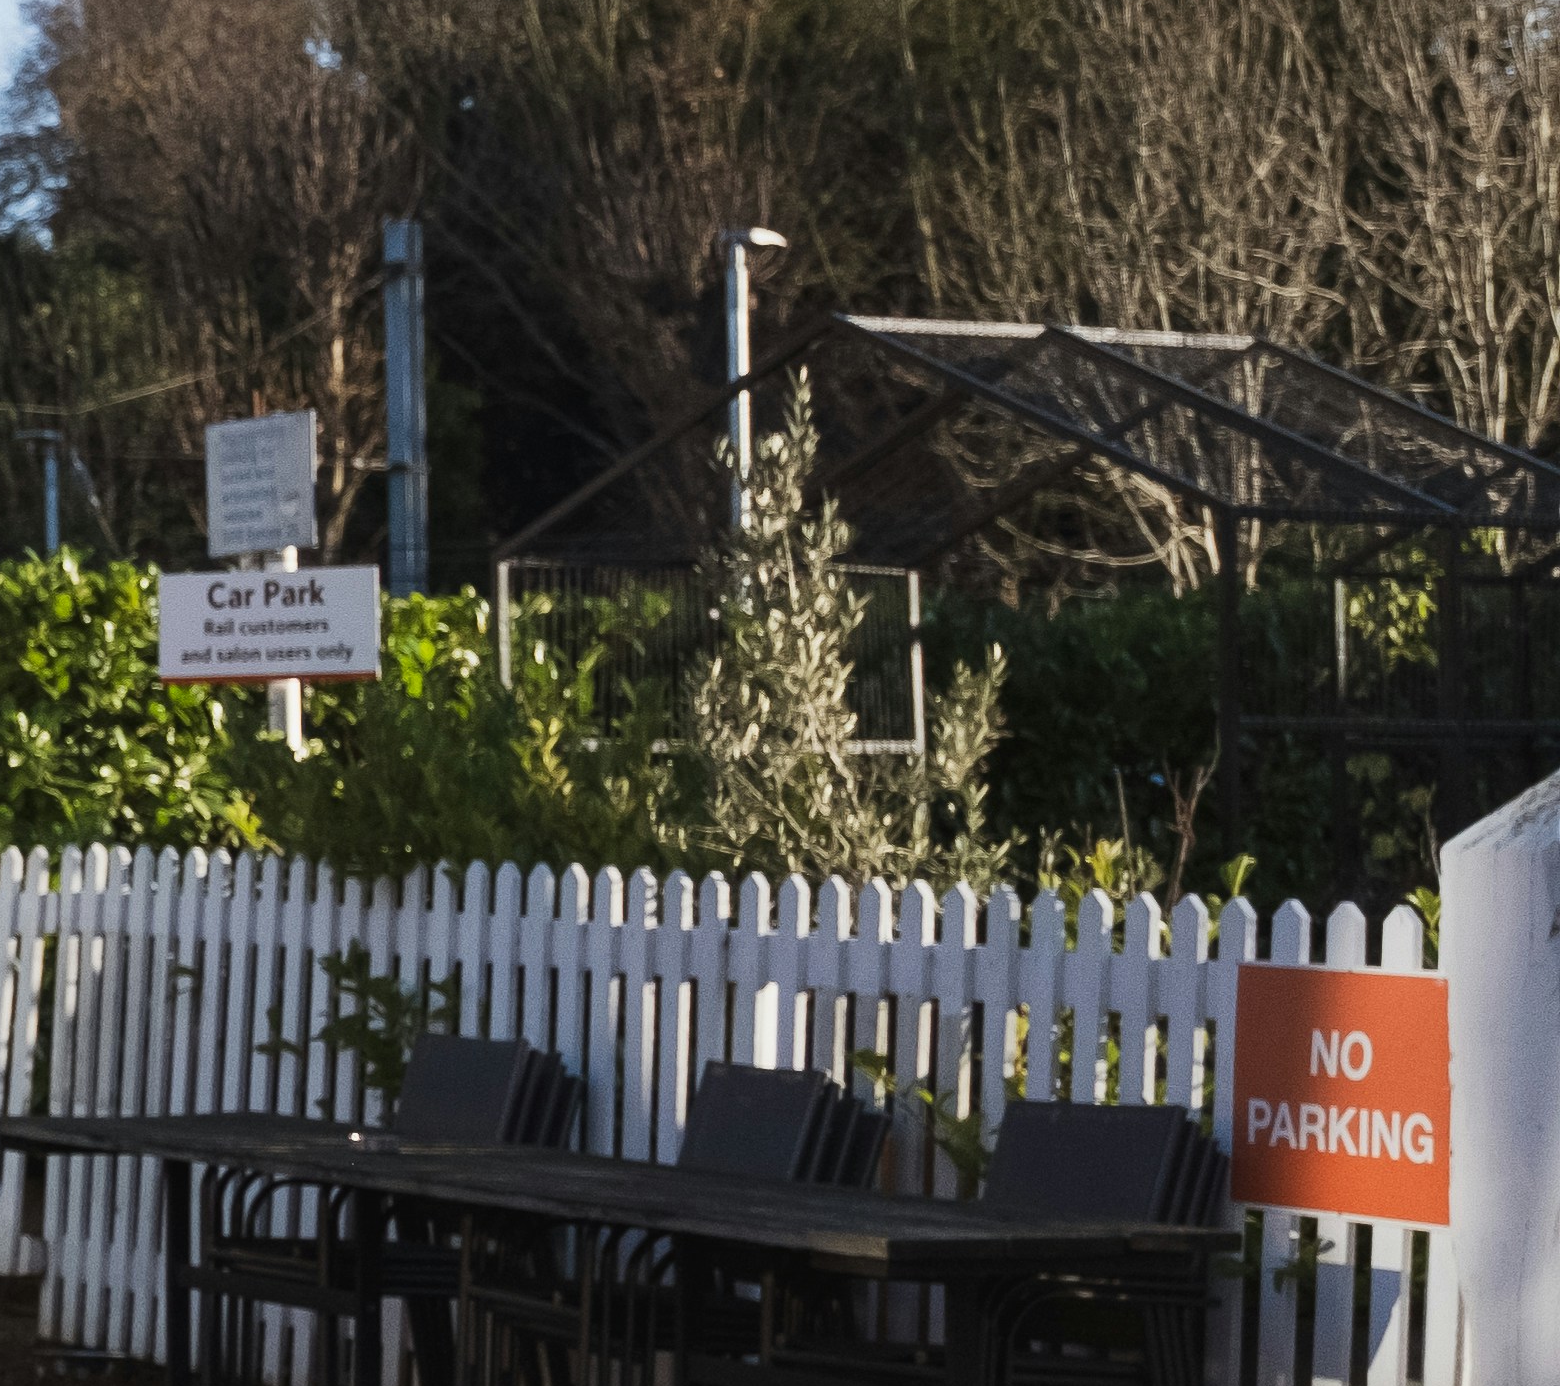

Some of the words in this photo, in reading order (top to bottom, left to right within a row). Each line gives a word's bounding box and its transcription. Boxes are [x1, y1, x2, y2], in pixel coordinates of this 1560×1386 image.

[207, 581, 254, 609] Car
[263, 578, 324, 608] Park
[204, 618, 234, 635] Rail
[239, 618, 329, 636] customers
[181, 647, 211, 663] and
[217, 646, 261, 661] salon
[266, 647, 311, 661] users
[317, 641, 354, 663] only
[1310, 1028, 1373, 1081] NO
[1247, 1098, 1435, 1164] PARKING
